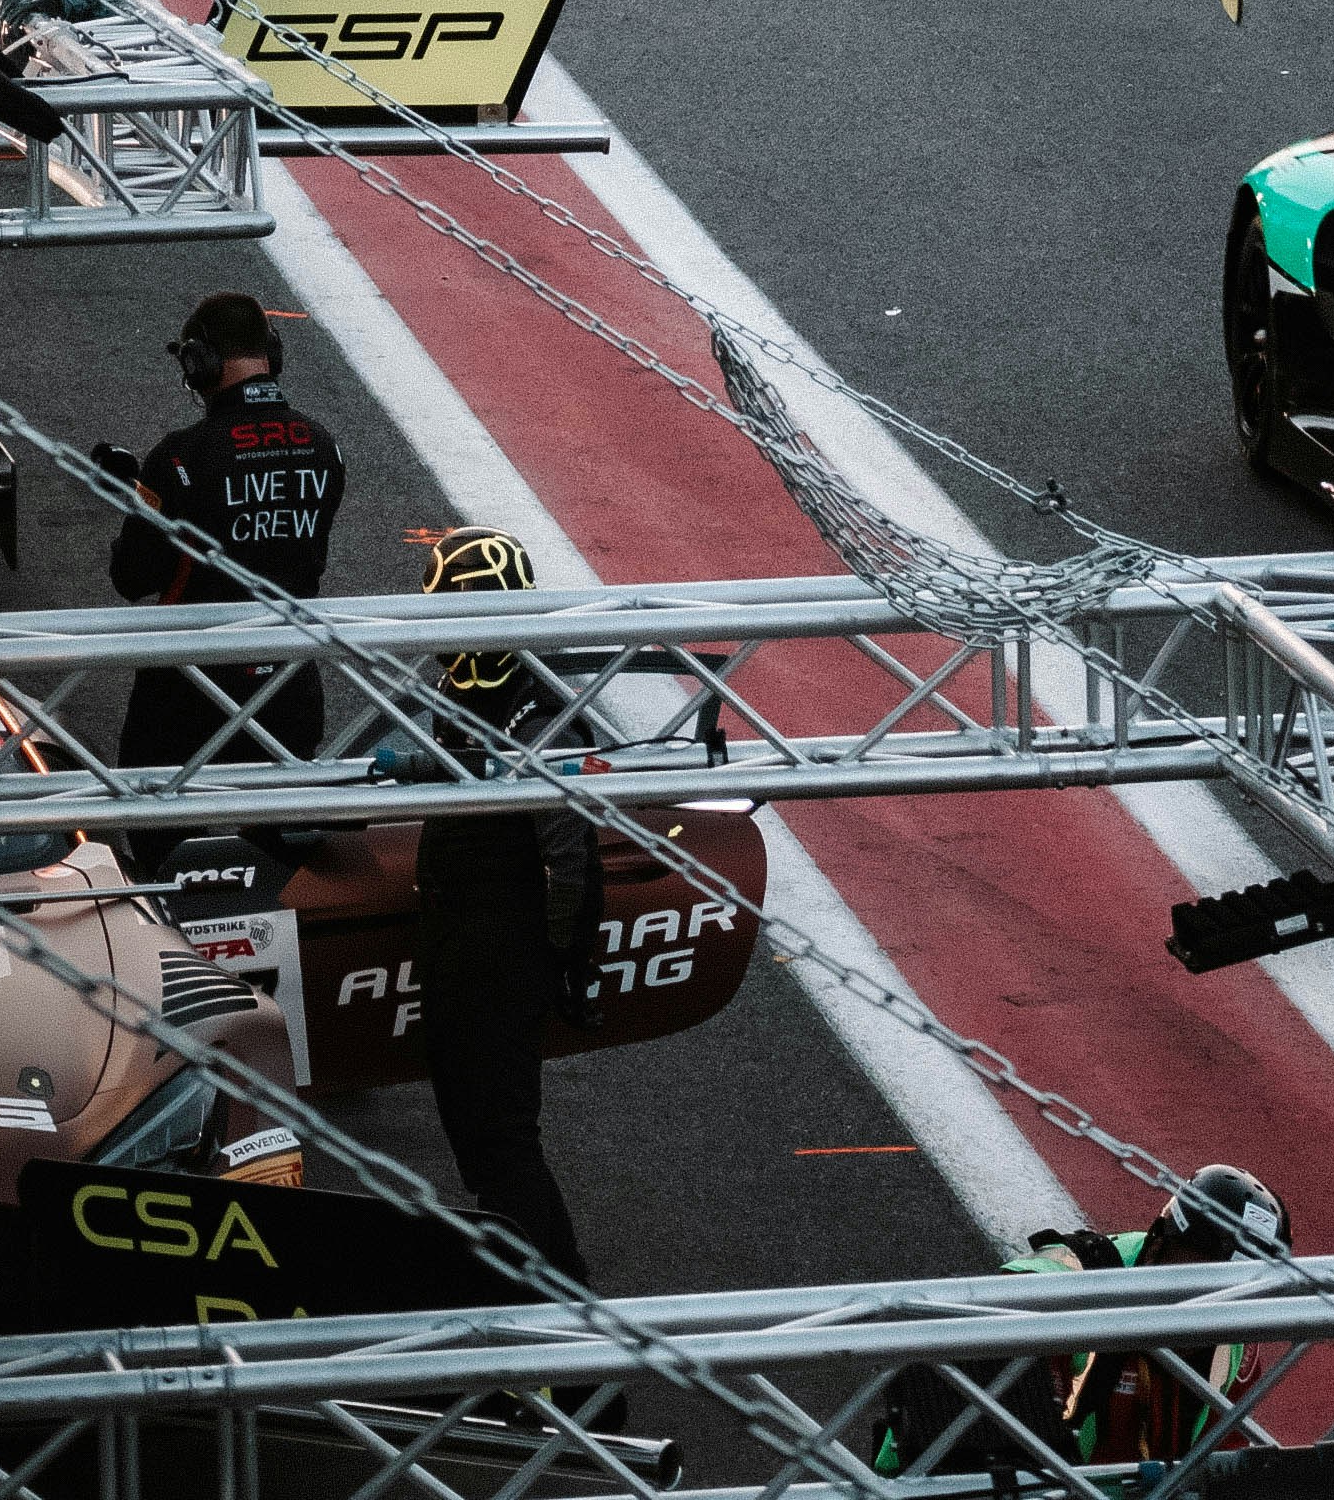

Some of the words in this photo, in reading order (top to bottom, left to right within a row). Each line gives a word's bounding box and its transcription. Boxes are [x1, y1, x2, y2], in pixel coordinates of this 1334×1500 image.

[245, 11, 505, 62] GSP
[225, 470, 287, 506] LIVE
[299, 469, 328, 500] TV
[232, 508, 320, 541] CREW
[182, 920, 247, 937] WDSTRIKE
[231, 1131, 292, 1160] RAVENOL
[72, 1184, 280, 1269] CSA
